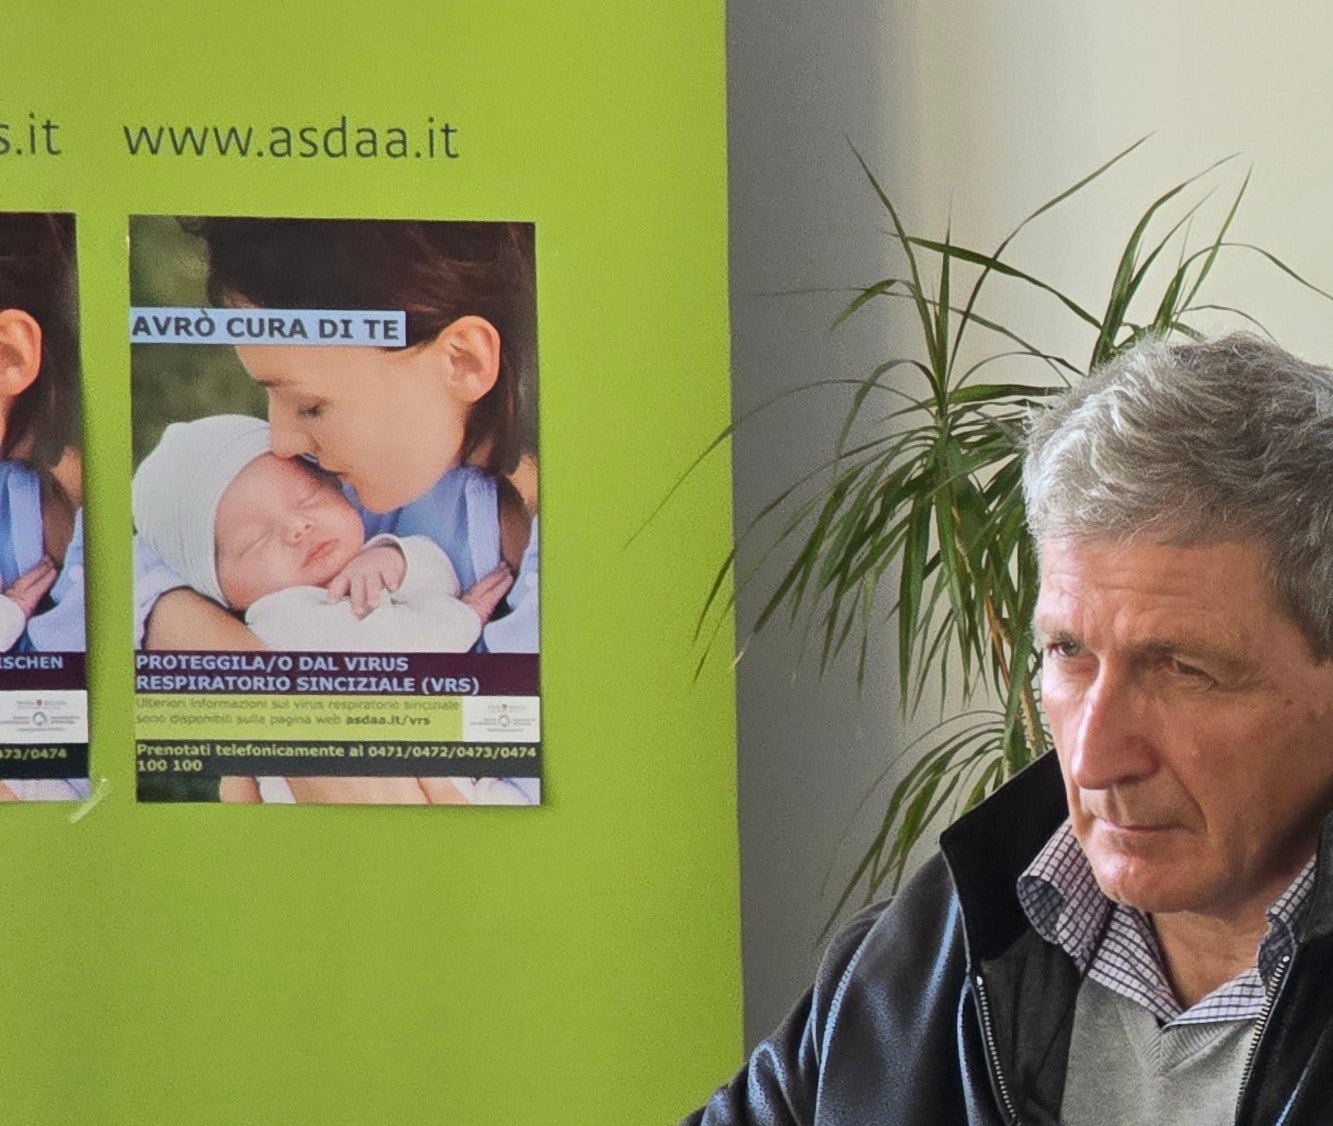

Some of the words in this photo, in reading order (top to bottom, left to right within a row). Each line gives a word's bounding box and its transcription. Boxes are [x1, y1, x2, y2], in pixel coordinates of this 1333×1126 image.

[122, 116, 459, 159] www.asdaa.it
[131, 310, 216, 338] AVRÒ
[226, 316, 308, 340] CURA
[319, 318, 353, 340] DI
[364, 319, 400, 341] TE
[0, 656, 64, 670] SCHEN
[136, 654, 293, 672] PROTEGGILA/O
[299, 656, 339, 671] DAL
[344, 657, 409, 672] VIRUS
[136, 675, 291, 691] RESPIRATORIO
[297, 676, 416, 692] SINCIZIALE
[421, 677, 480, 695] (VRS)
[136, 744, 211, 756] Prenotati
[215, 744, 345, 757] telefonicamente
[137, 760, 168, 772] 100
[173, 760, 203, 772] 100
